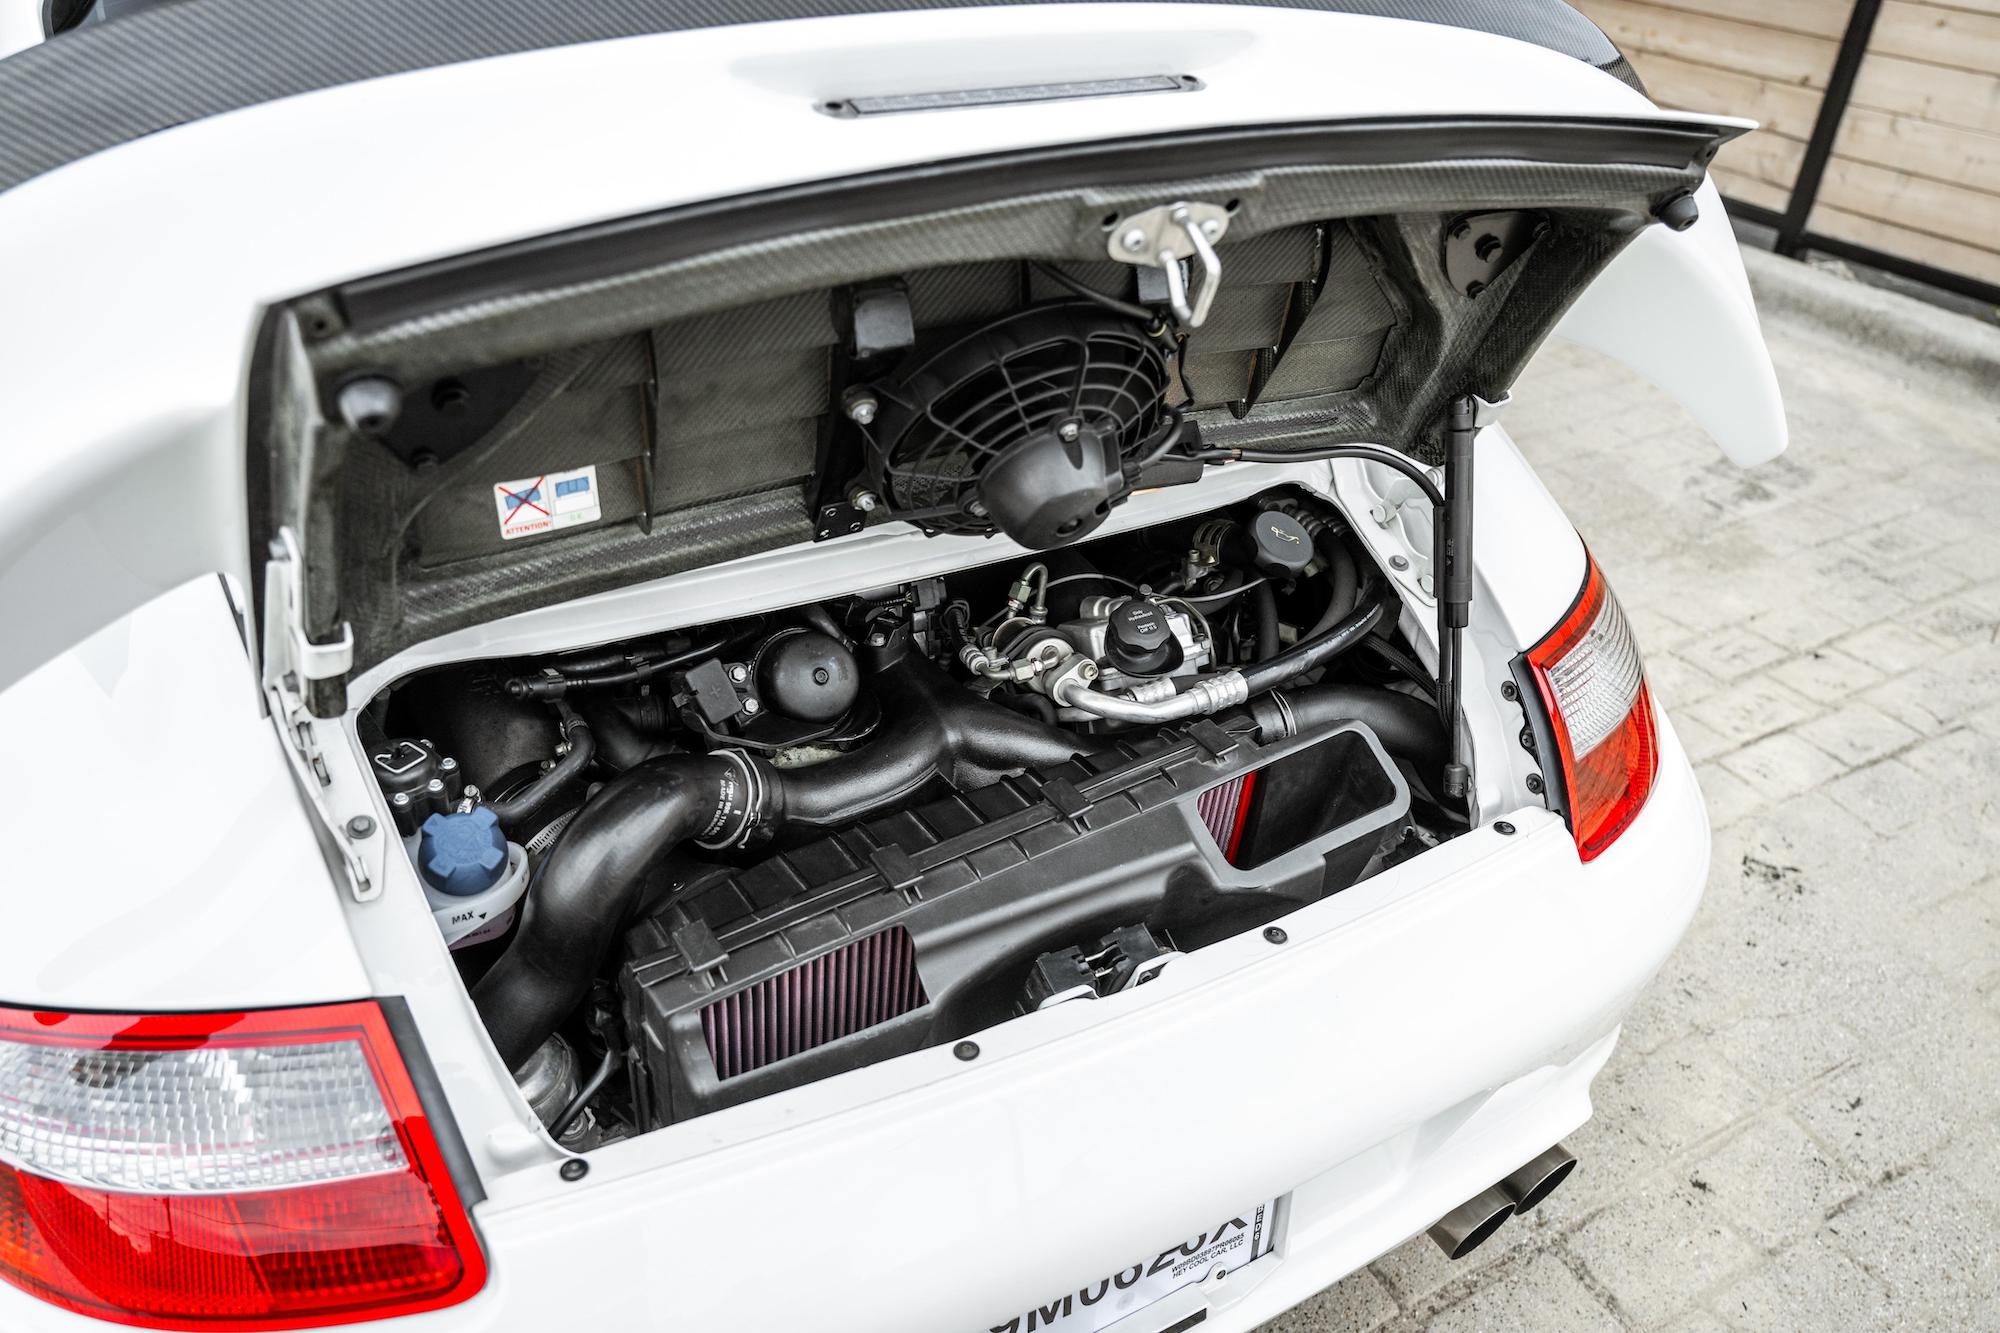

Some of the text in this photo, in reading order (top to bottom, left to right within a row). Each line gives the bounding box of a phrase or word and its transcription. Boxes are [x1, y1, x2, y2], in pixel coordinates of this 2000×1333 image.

[452, 910, 474, 924] MAX
[1172, 1267, 1187, 1279] HEY
[1188, 1256, 1209, 1270] COOL
[1229, 1239, 1244, 1250] LLC
